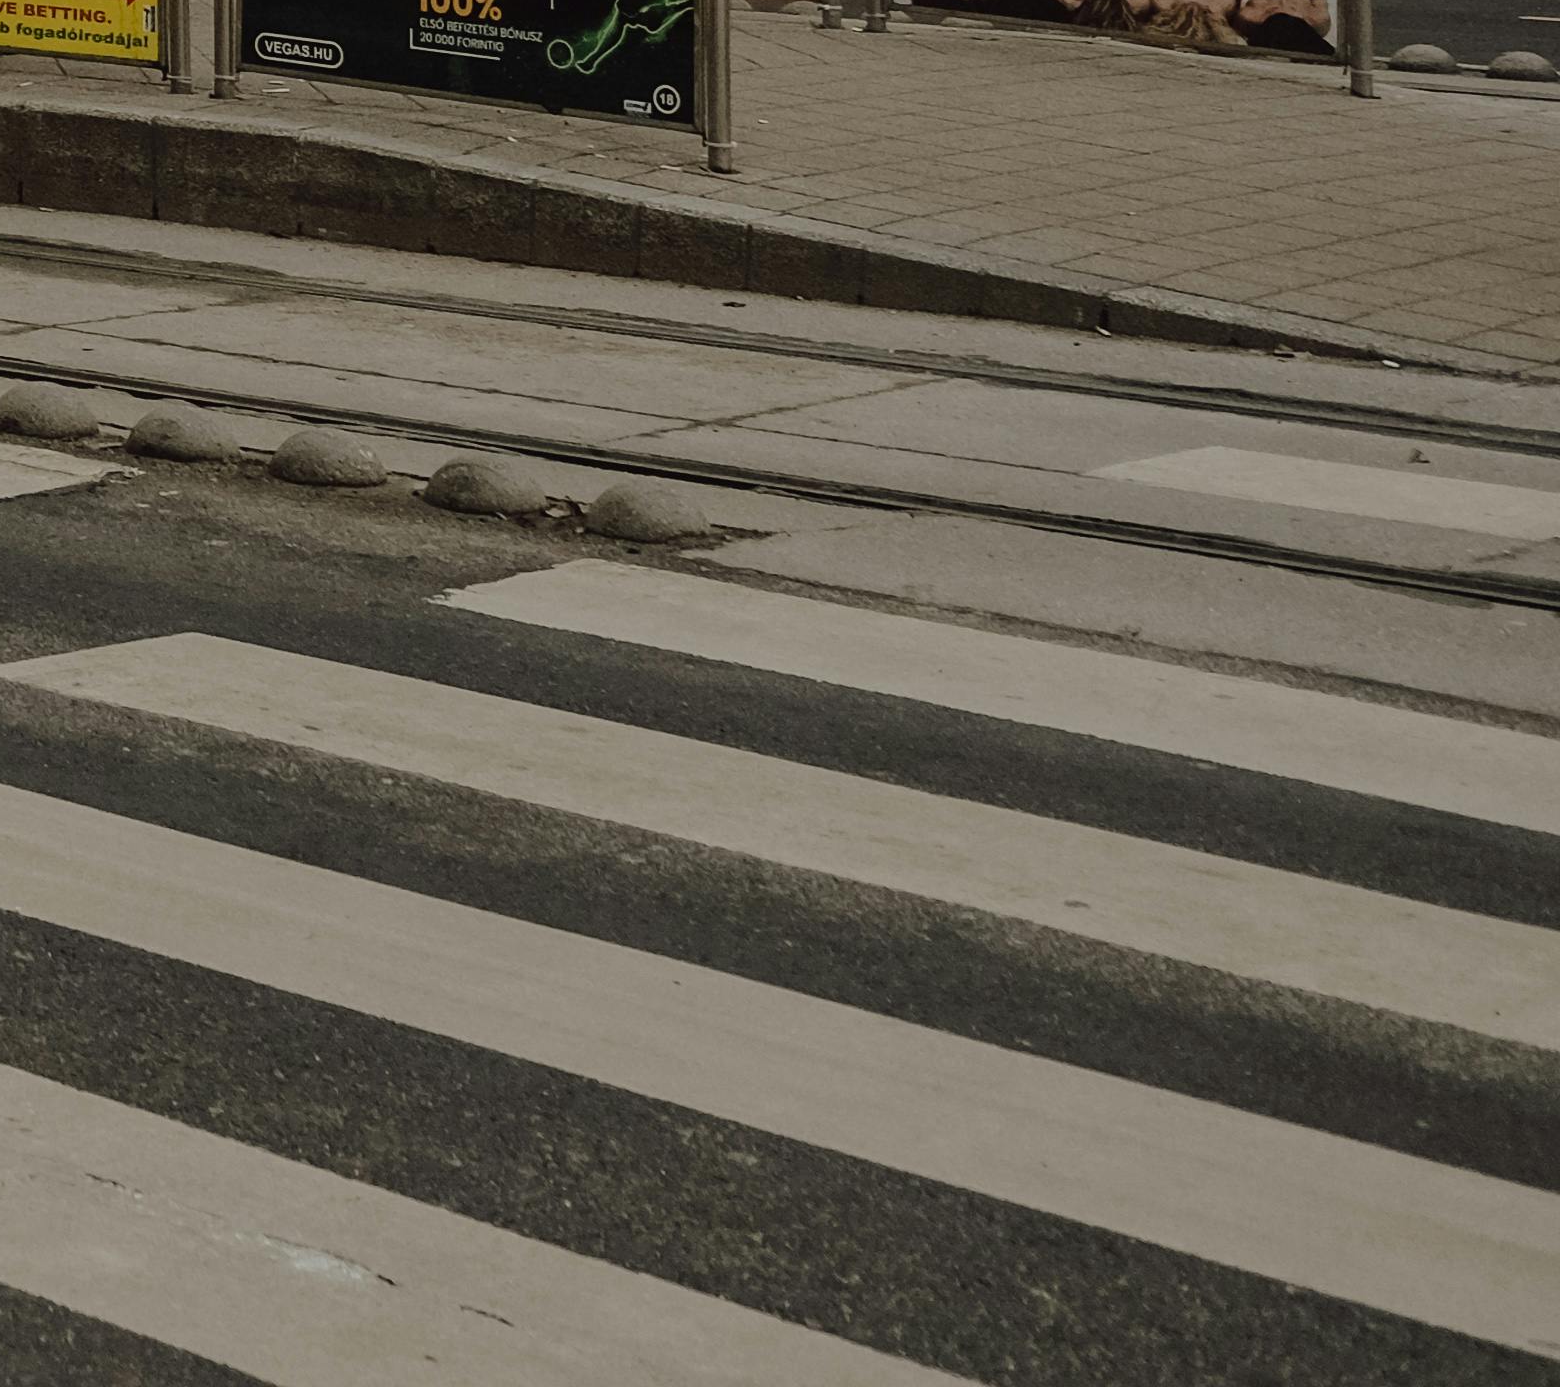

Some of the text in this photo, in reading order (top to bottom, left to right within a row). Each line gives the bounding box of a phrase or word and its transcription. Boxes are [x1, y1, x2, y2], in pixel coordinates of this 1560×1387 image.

[23, 3, 113, 25] BETTING.
[419, 31, 505, 53] 20 000 FORINTIG
[499, 26, 544, 43] BÓNUSZ
[264, 39, 334, 62] VEGAS.HU
[658, 92, 675, 106] 18
